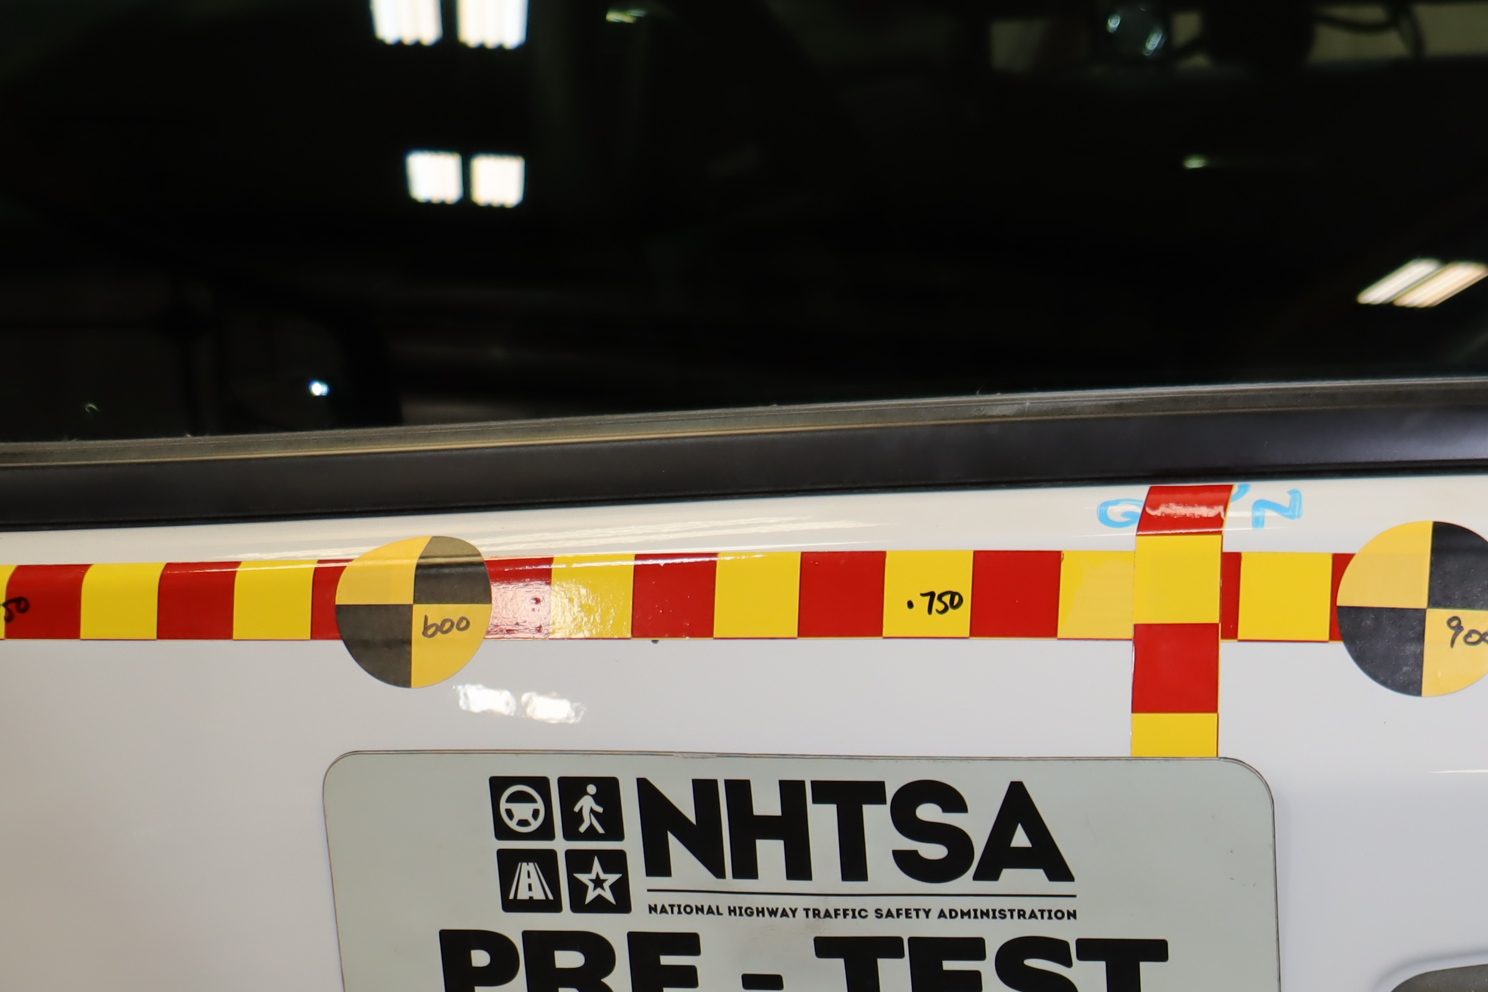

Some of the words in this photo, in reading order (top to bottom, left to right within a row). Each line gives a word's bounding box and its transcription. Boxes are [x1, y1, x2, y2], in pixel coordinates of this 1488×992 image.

[421, 615, 470, 639] 600
[636, 777, 1075, 884] NHTSA
[648, 903, 724, 917] NATIONAL
[727, 905, 799, 919] HIGHWAY
[802, 907, 869, 920] TRAFFIC
[874, 907, 932, 920] SAFETY
[937, 908, 1078, 921] ADMINISTRATION
